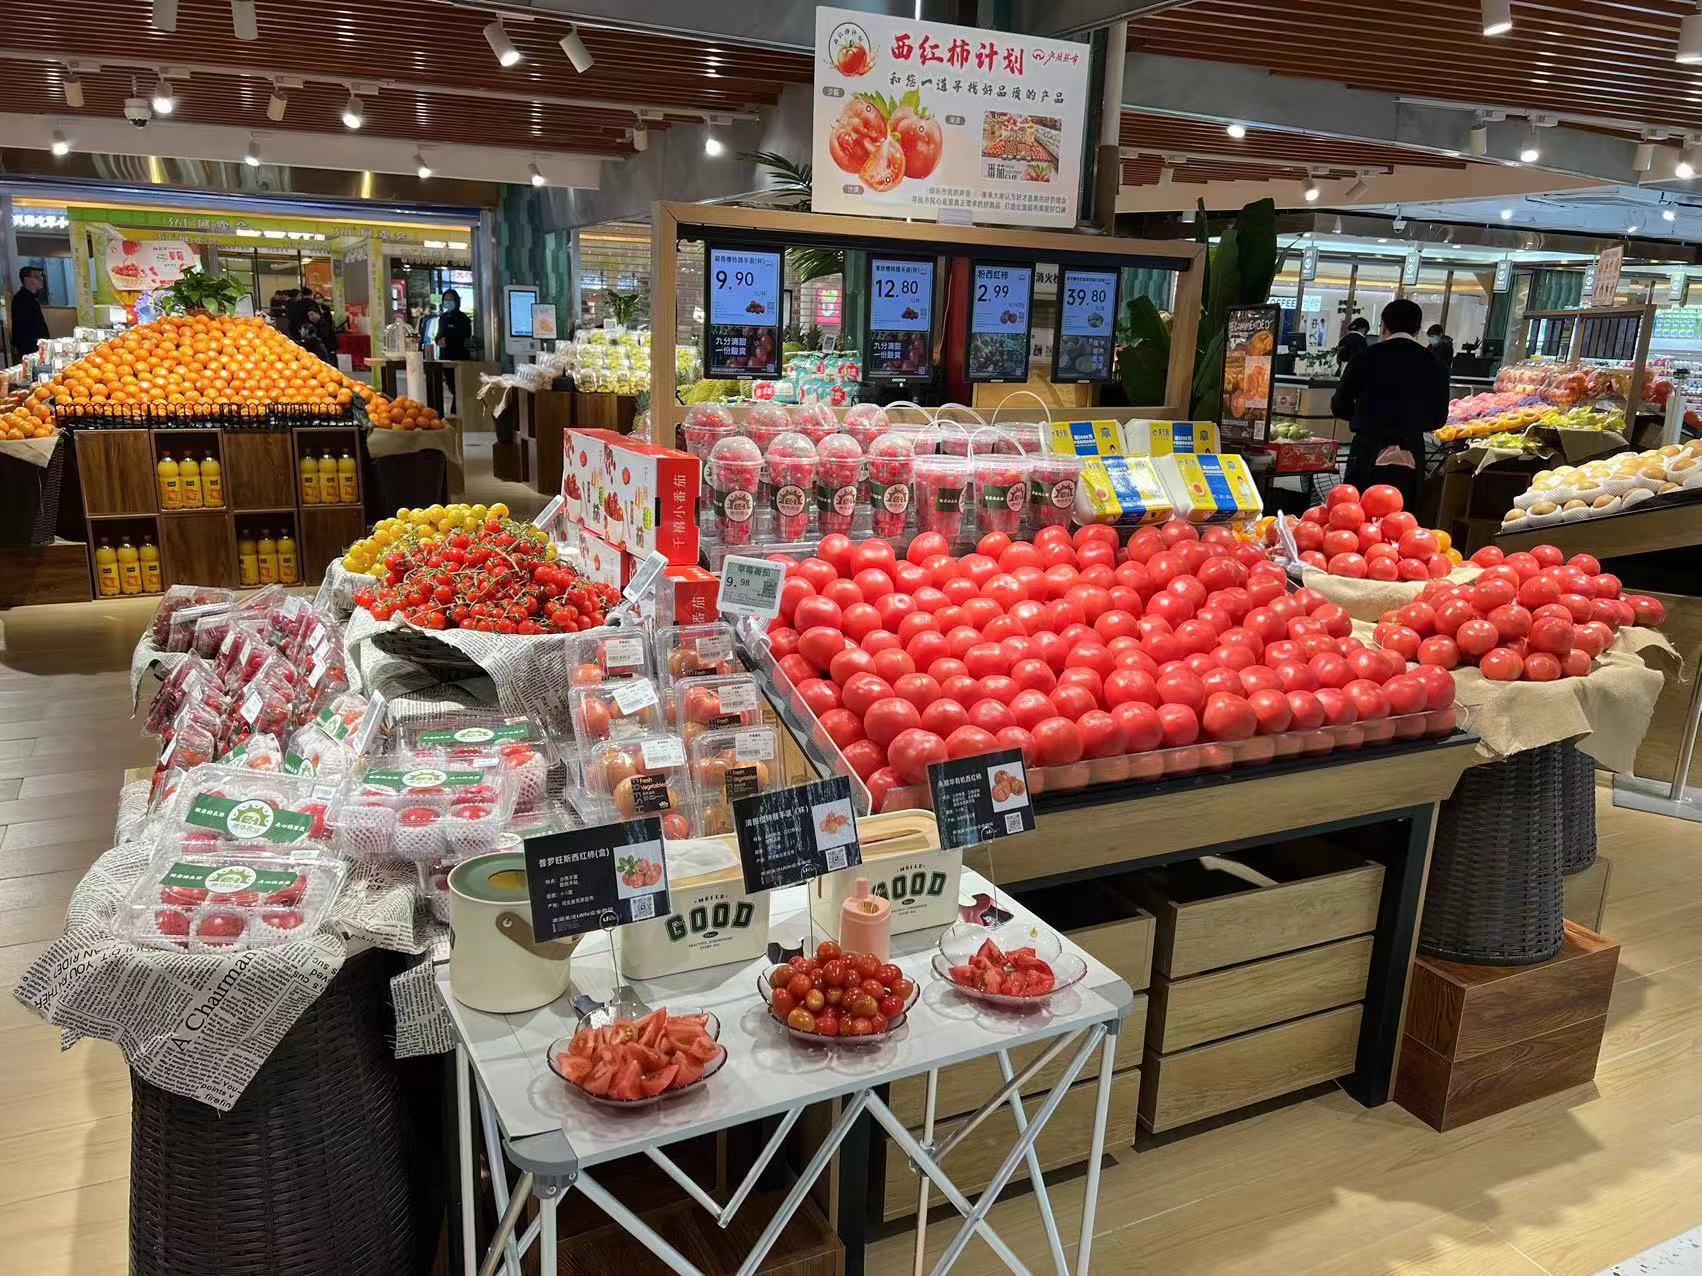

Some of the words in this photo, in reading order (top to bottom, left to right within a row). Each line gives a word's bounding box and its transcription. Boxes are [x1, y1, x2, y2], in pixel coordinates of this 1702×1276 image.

[891, 33, 1024, 76] 西红柿计划
[889, 72, 1065, 104] 和您一道寻找好品质的产品
[715, 270, 754, 290] 9.90
[977, 270, 1009, 280] 粉西红柿
[875, 279, 918, 298] 12.80
[977, 284, 1009, 302] 2.99
[1066, 288, 1106, 306] 39.80
[672, 474, 687, 550] 千禧小番茄
[726, 576, 750, 587] 9.98
[640, 782, 667, 790] Vegetables
[538, 848, 610, 868] 普罗旺斯西红柿(盒)
[698, 894, 725, 903] MEILE
[665, 901, 755, 942] GOOD
[170, 1034, 192, 1051] A
[185, 949, 256, 1032] Chairman
